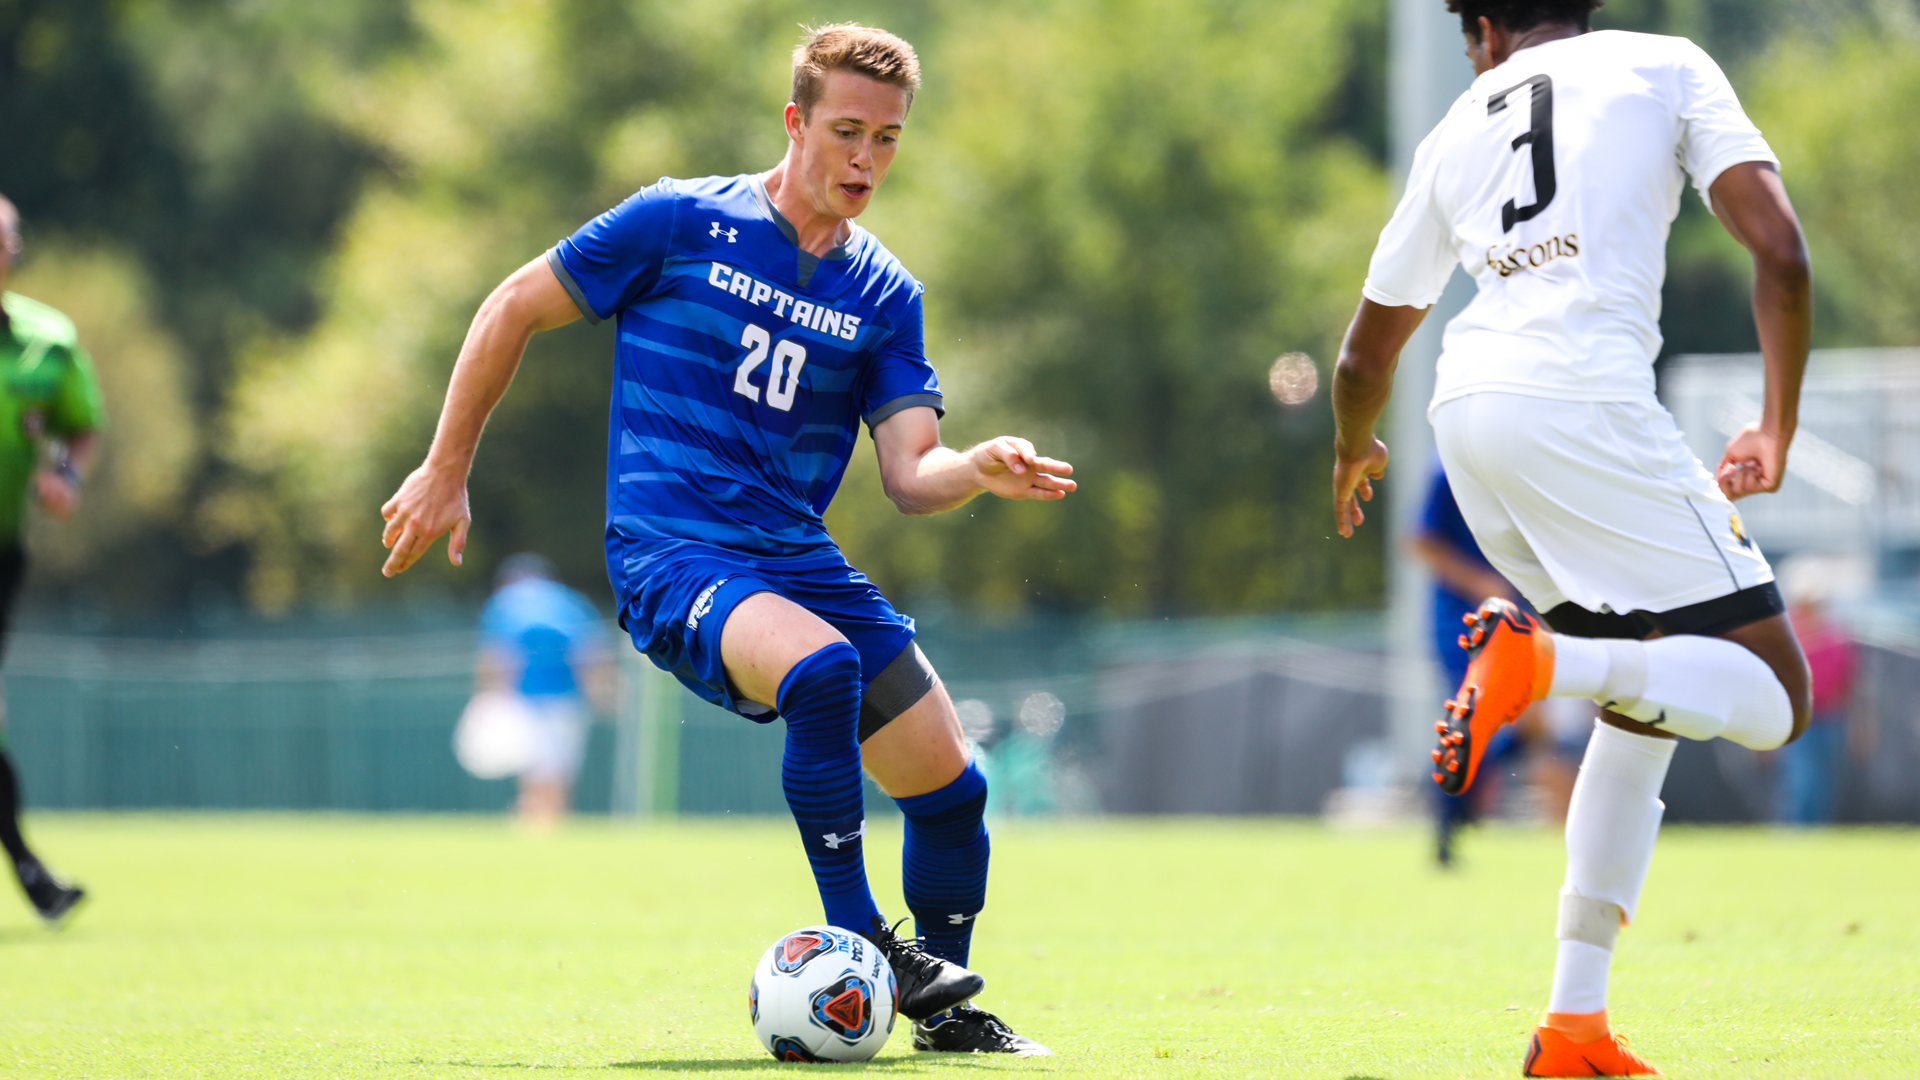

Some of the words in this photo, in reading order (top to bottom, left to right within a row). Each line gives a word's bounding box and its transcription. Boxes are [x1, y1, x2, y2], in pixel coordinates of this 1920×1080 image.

[1487, 73, 1556, 234] 3
[708, 261, 862, 341] CAPTAINS
[733, 323, 807, 412] 20
